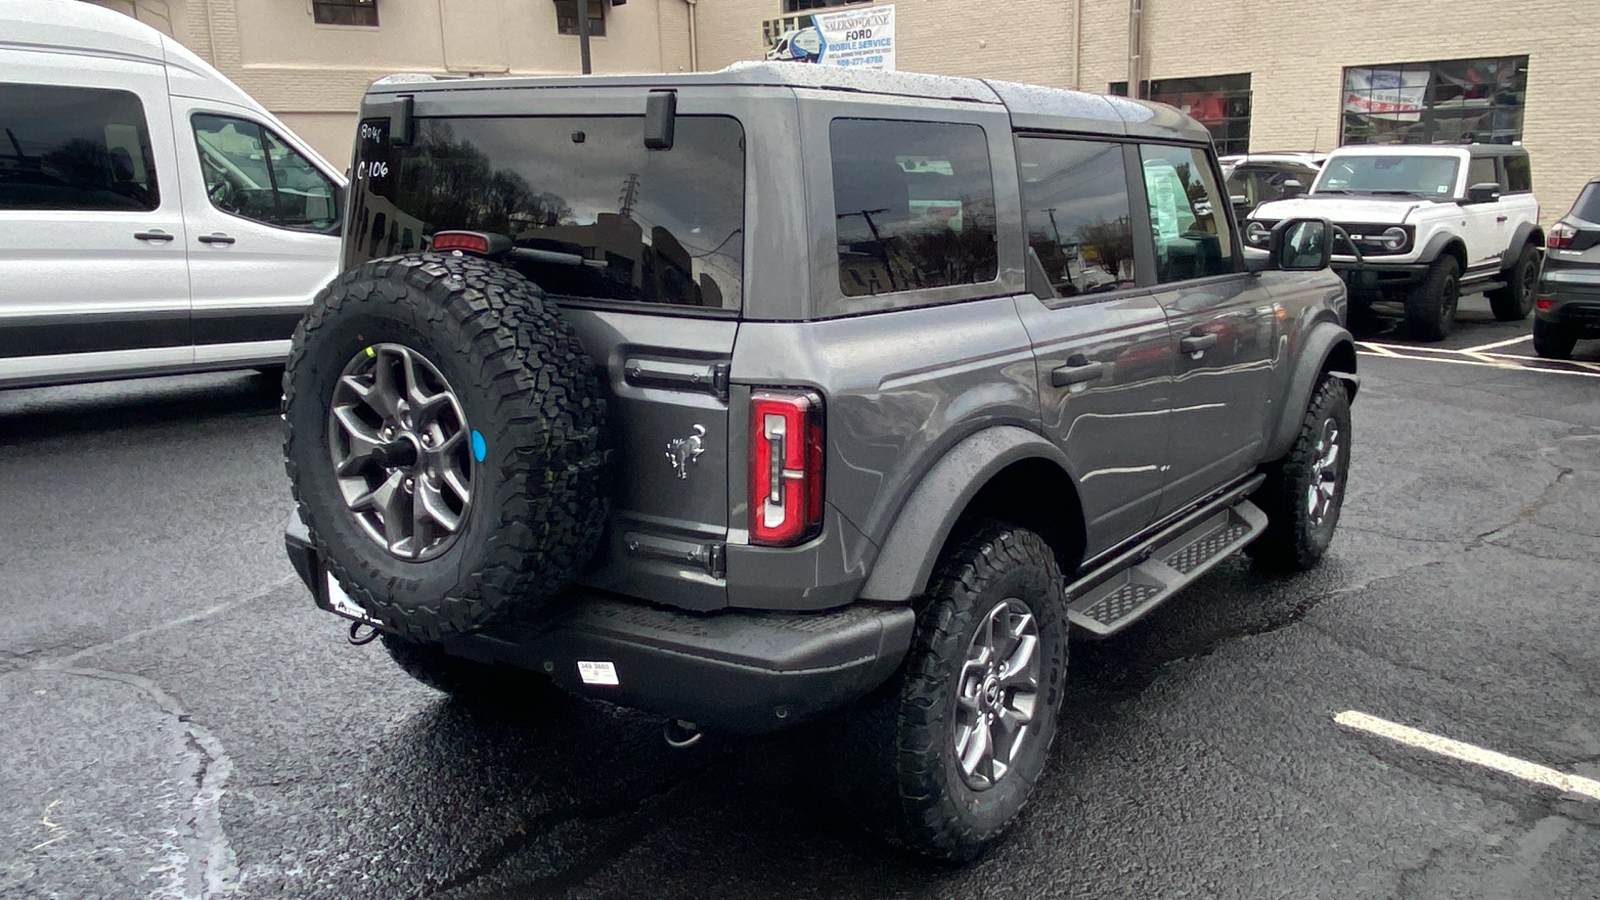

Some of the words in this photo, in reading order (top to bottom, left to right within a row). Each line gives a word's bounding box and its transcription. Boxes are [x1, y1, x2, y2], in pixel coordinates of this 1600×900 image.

[845, 28, 872, 41] FORD
[828, 41, 857, 51] MOBILE
[858, 38, 891, 49] SERVICE
